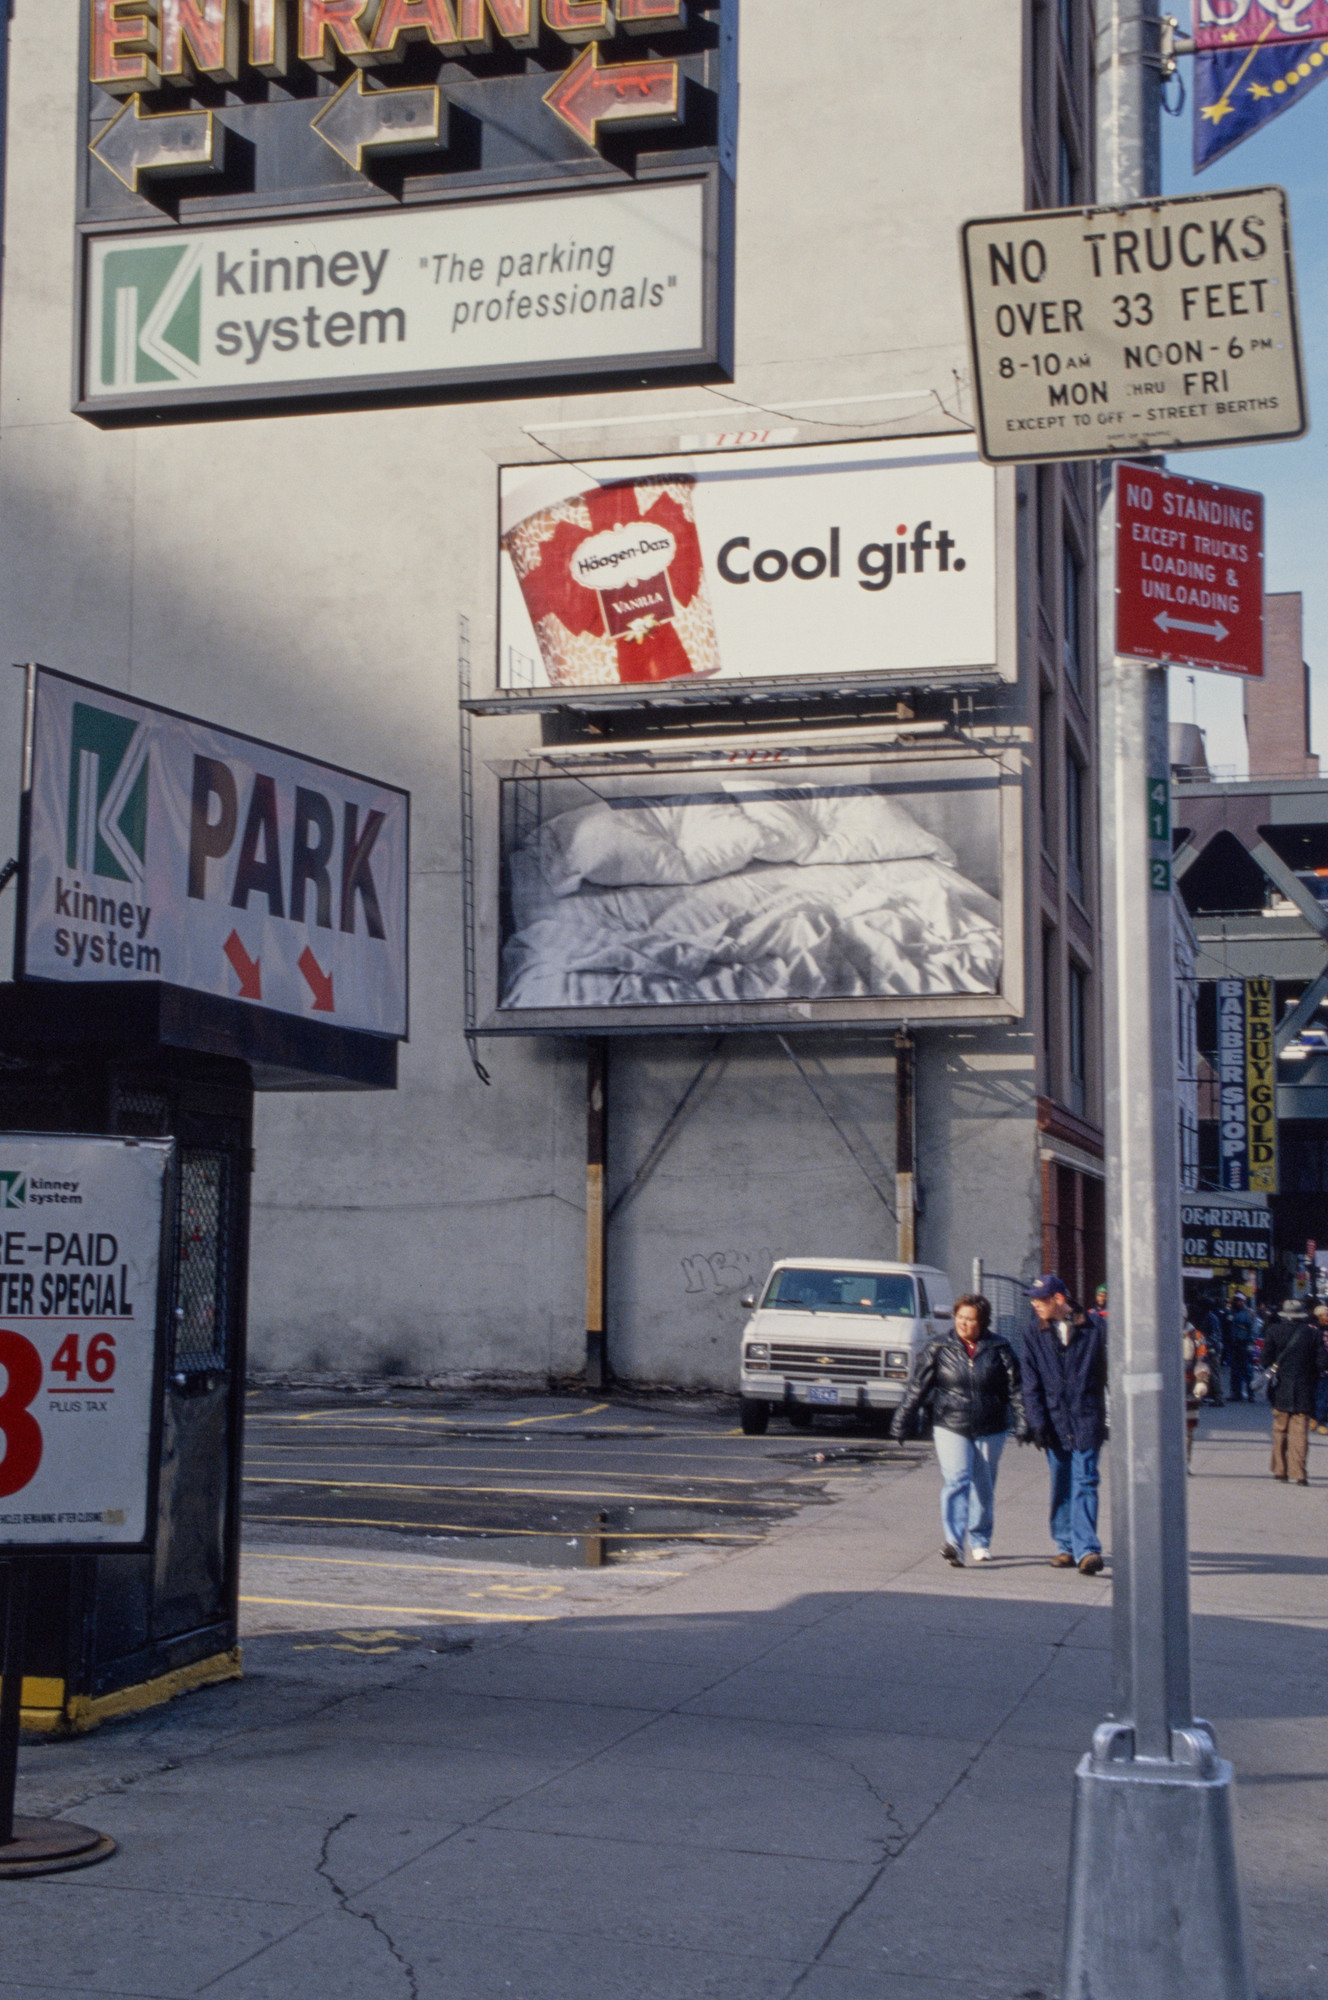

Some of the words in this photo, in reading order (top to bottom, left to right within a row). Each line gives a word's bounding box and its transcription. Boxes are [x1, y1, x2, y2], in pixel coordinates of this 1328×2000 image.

[216, 248, 390, 298] kinney
[497, 240, 616, 288] parking
[989, 239, 1047, 286] NO
[1083, 215, 1267, 278] TRUCKS
[996, 299, 1084, 337] OVER
[1113, 293, 1154, 328] 33
[1181, 279, 1269, 321] FEET
[215, 305, 406, 366] system
[1048, 381, 1109, 407] MON
[1184, 369, 1229, 396] FRI
[1006, 415, 1065, 431] EXCEPT
[1073, 413, 1092, 427] TO
[1216, 396, 1280, 415] BERTHS
[1126, 483, 1153, 511] NO
[1163, 492, 1254, 532] STANDING
[716, 526, 840, 584] Cool
[857, 520, 967, 591] gift.
[1132, 522, 1188, 550] EXCEPT
[1193, 535, 1249, 563] TRUCKS
[1141, 551, 1216, 582] LOADING
[1226, 568, 1239, 588] &
[611, 592, 664, 614] VANILLA
[1141, 579, 1240, 614] UNLOADING
[187, 753, 387, 941] PARK
[54, 876, 151, 938] kinney
[54, 926, 161, 974] system
[1220, 980, 1244, 1083] BARBER
[1222, 1086, 1246, 1157] SHOP
[1250, 1084, 1273, 1163] GOLD
[30, 1178, 79, 1192] kinney
[30, 1193, 82, 1205] system
[1209, 1208, 1271, 1229] REPAIR
[0, 1231, 118, 1266] E-PAID
[1213, 1240, 1269, 1260] SHINE
[40, 1264, 133, 1315] SPECIAL
[51, 1332, 116, 1383] 46
[50, 1401, 82, 1412] PLUS
[86, 1401, 107, 1412] TAX
